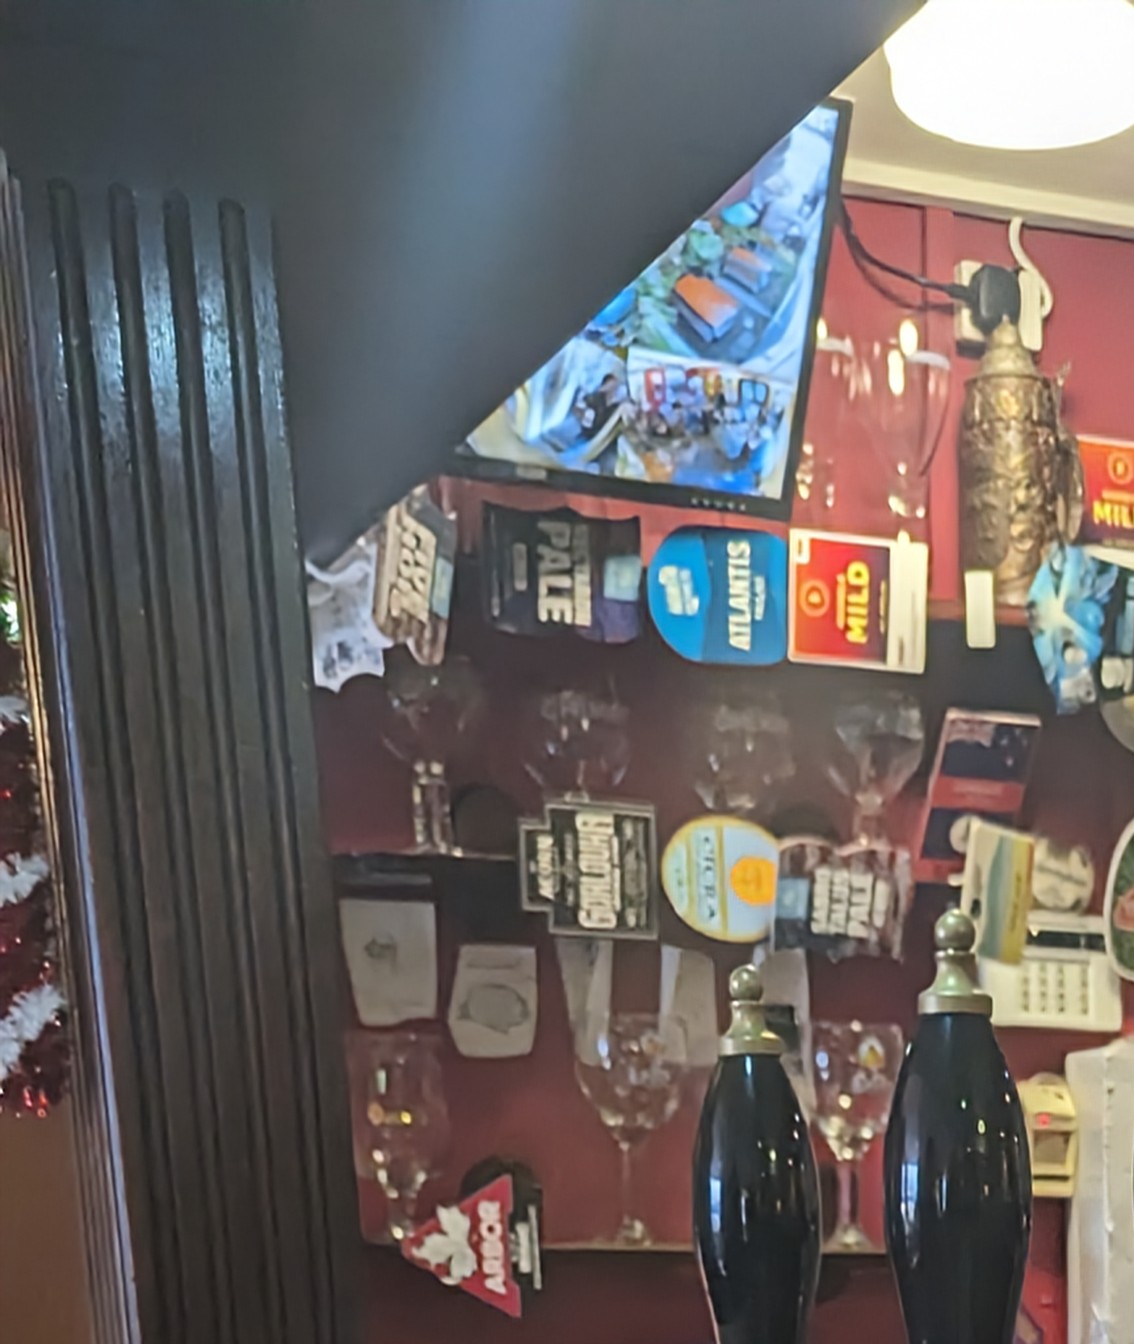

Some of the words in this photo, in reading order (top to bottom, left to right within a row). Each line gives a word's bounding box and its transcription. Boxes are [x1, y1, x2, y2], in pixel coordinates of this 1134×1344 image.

[537, 521, 575, 623] PALE
[727, 540, 750, 652] ATLANTIS
[845, 561, 870, 644] MILD
